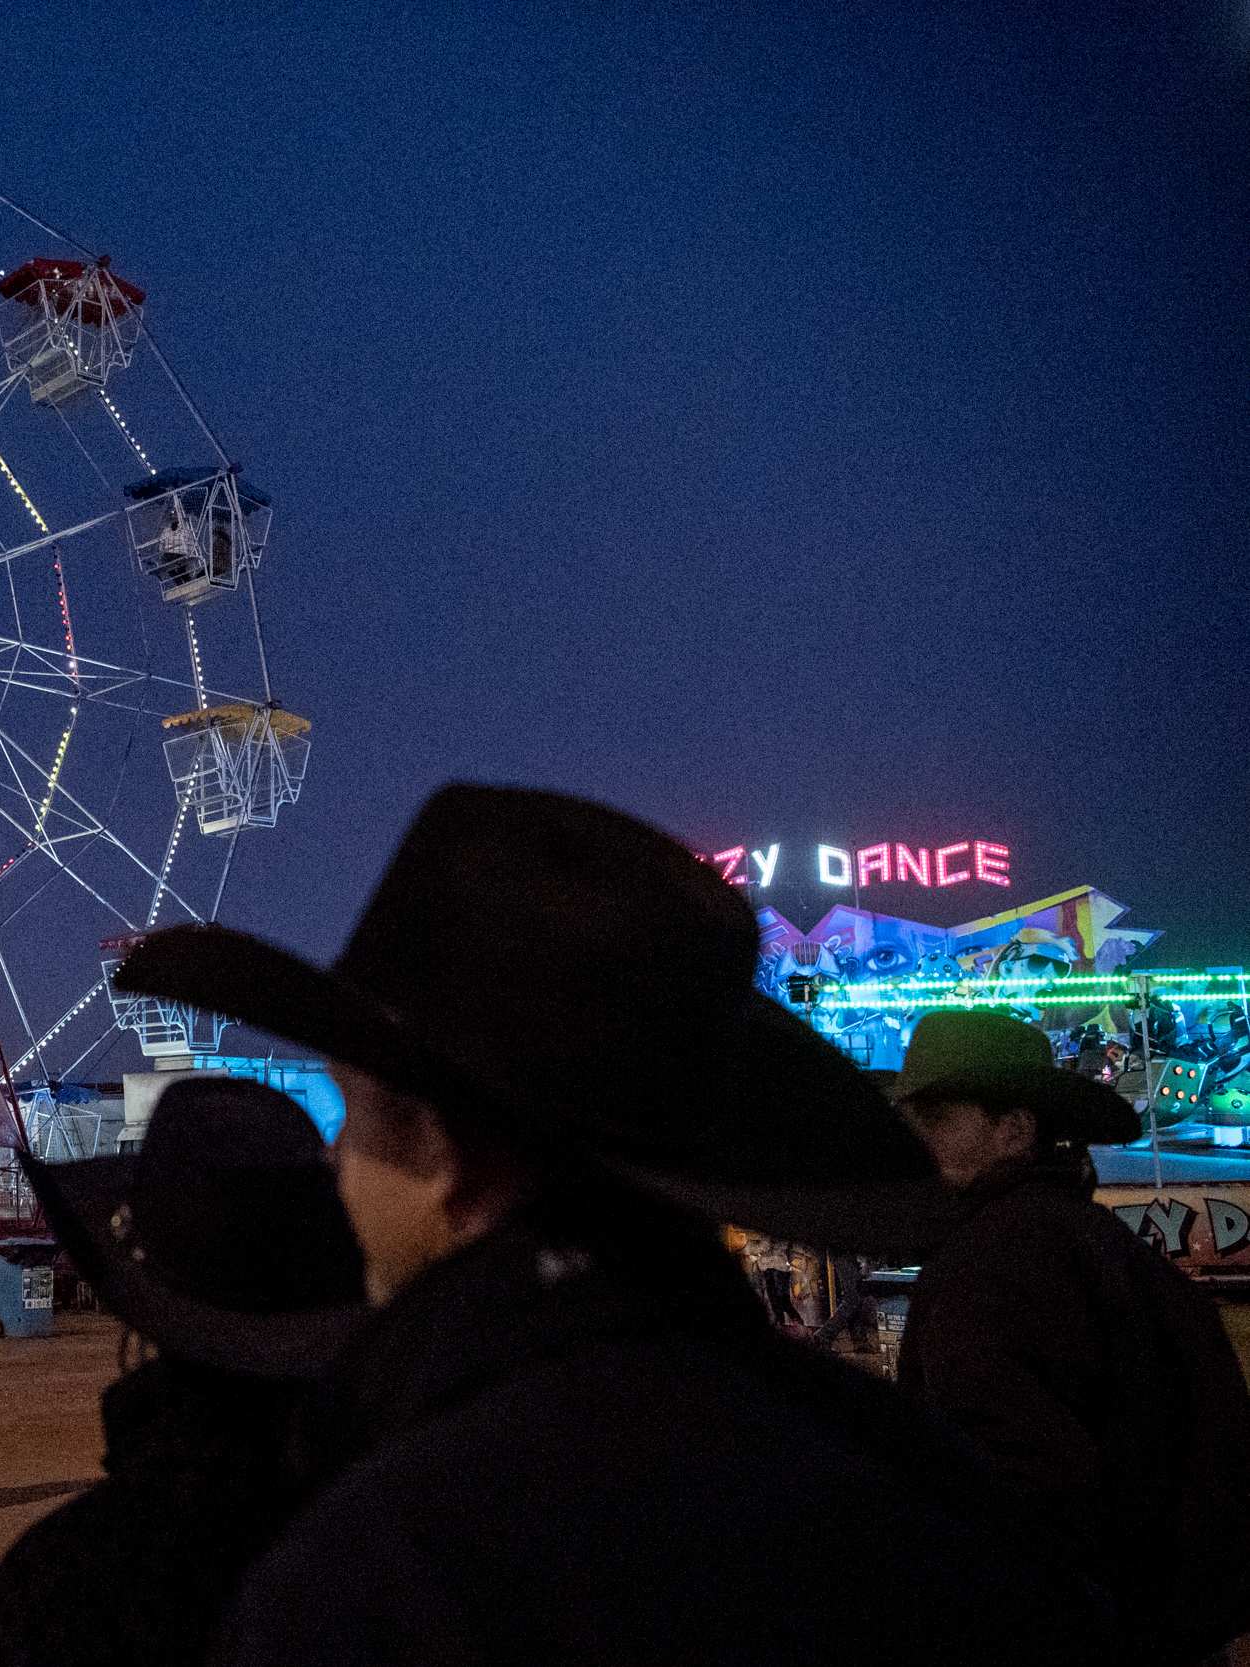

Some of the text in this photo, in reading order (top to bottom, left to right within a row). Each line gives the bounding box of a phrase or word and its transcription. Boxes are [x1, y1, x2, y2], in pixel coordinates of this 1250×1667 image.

[695, 839, 1011, 888] ZY DANCE
[1204, 1199, 1250, 1252] D
